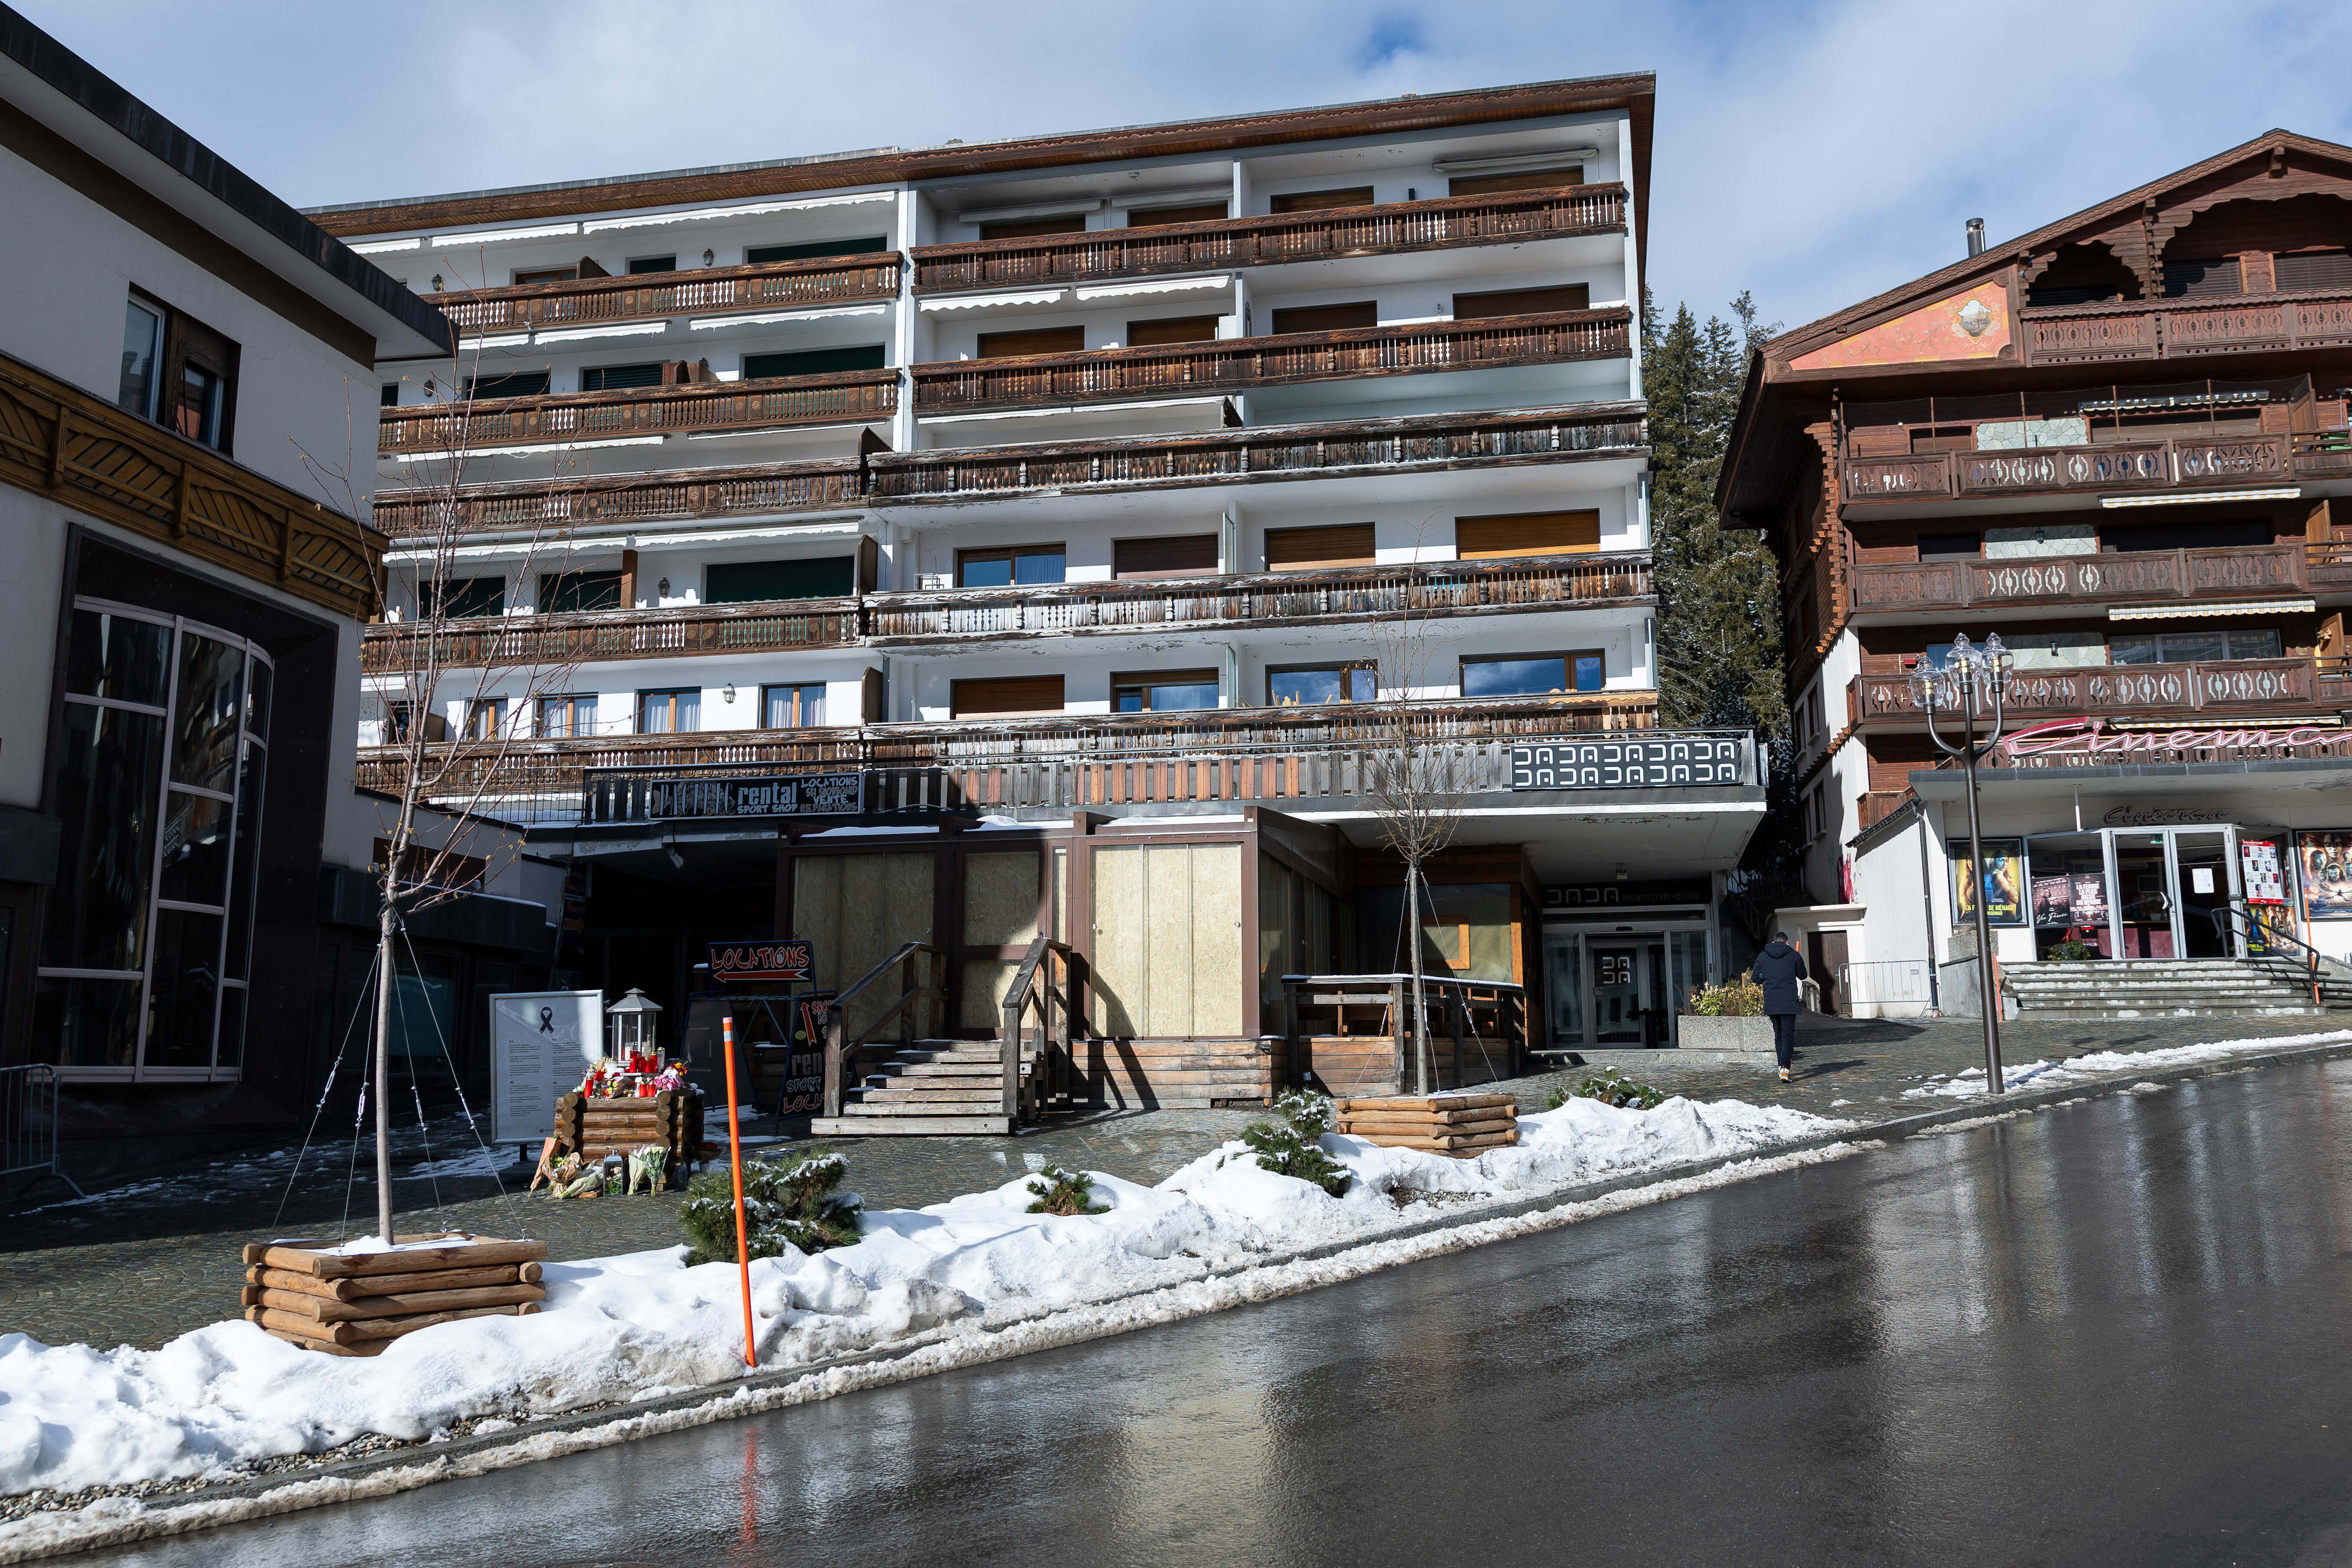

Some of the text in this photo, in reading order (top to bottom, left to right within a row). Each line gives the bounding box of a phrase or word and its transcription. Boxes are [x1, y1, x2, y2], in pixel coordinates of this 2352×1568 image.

[2001, 716, 2352, 755] Cinema
[801, 776, 858, 788] LOCATIONS
[659, 782, 733, 816] PACIFIC
[737, 782, 797, 804] rental
[806, 785, 858, 797] SKI SNOWBOARD
[813, 793, 849, 805] VENTE
[737, 803, 798, 814] SPORT SHOP
[800, 802, 858, 813] REPARATIONS
[2104, 805, 2231, 824] Cinécran
[1546, 887, 1619, 904] DADA
[711, 946, 810, 969] LOCATIONS
[786, 1076, 822, 1093] SPORT
